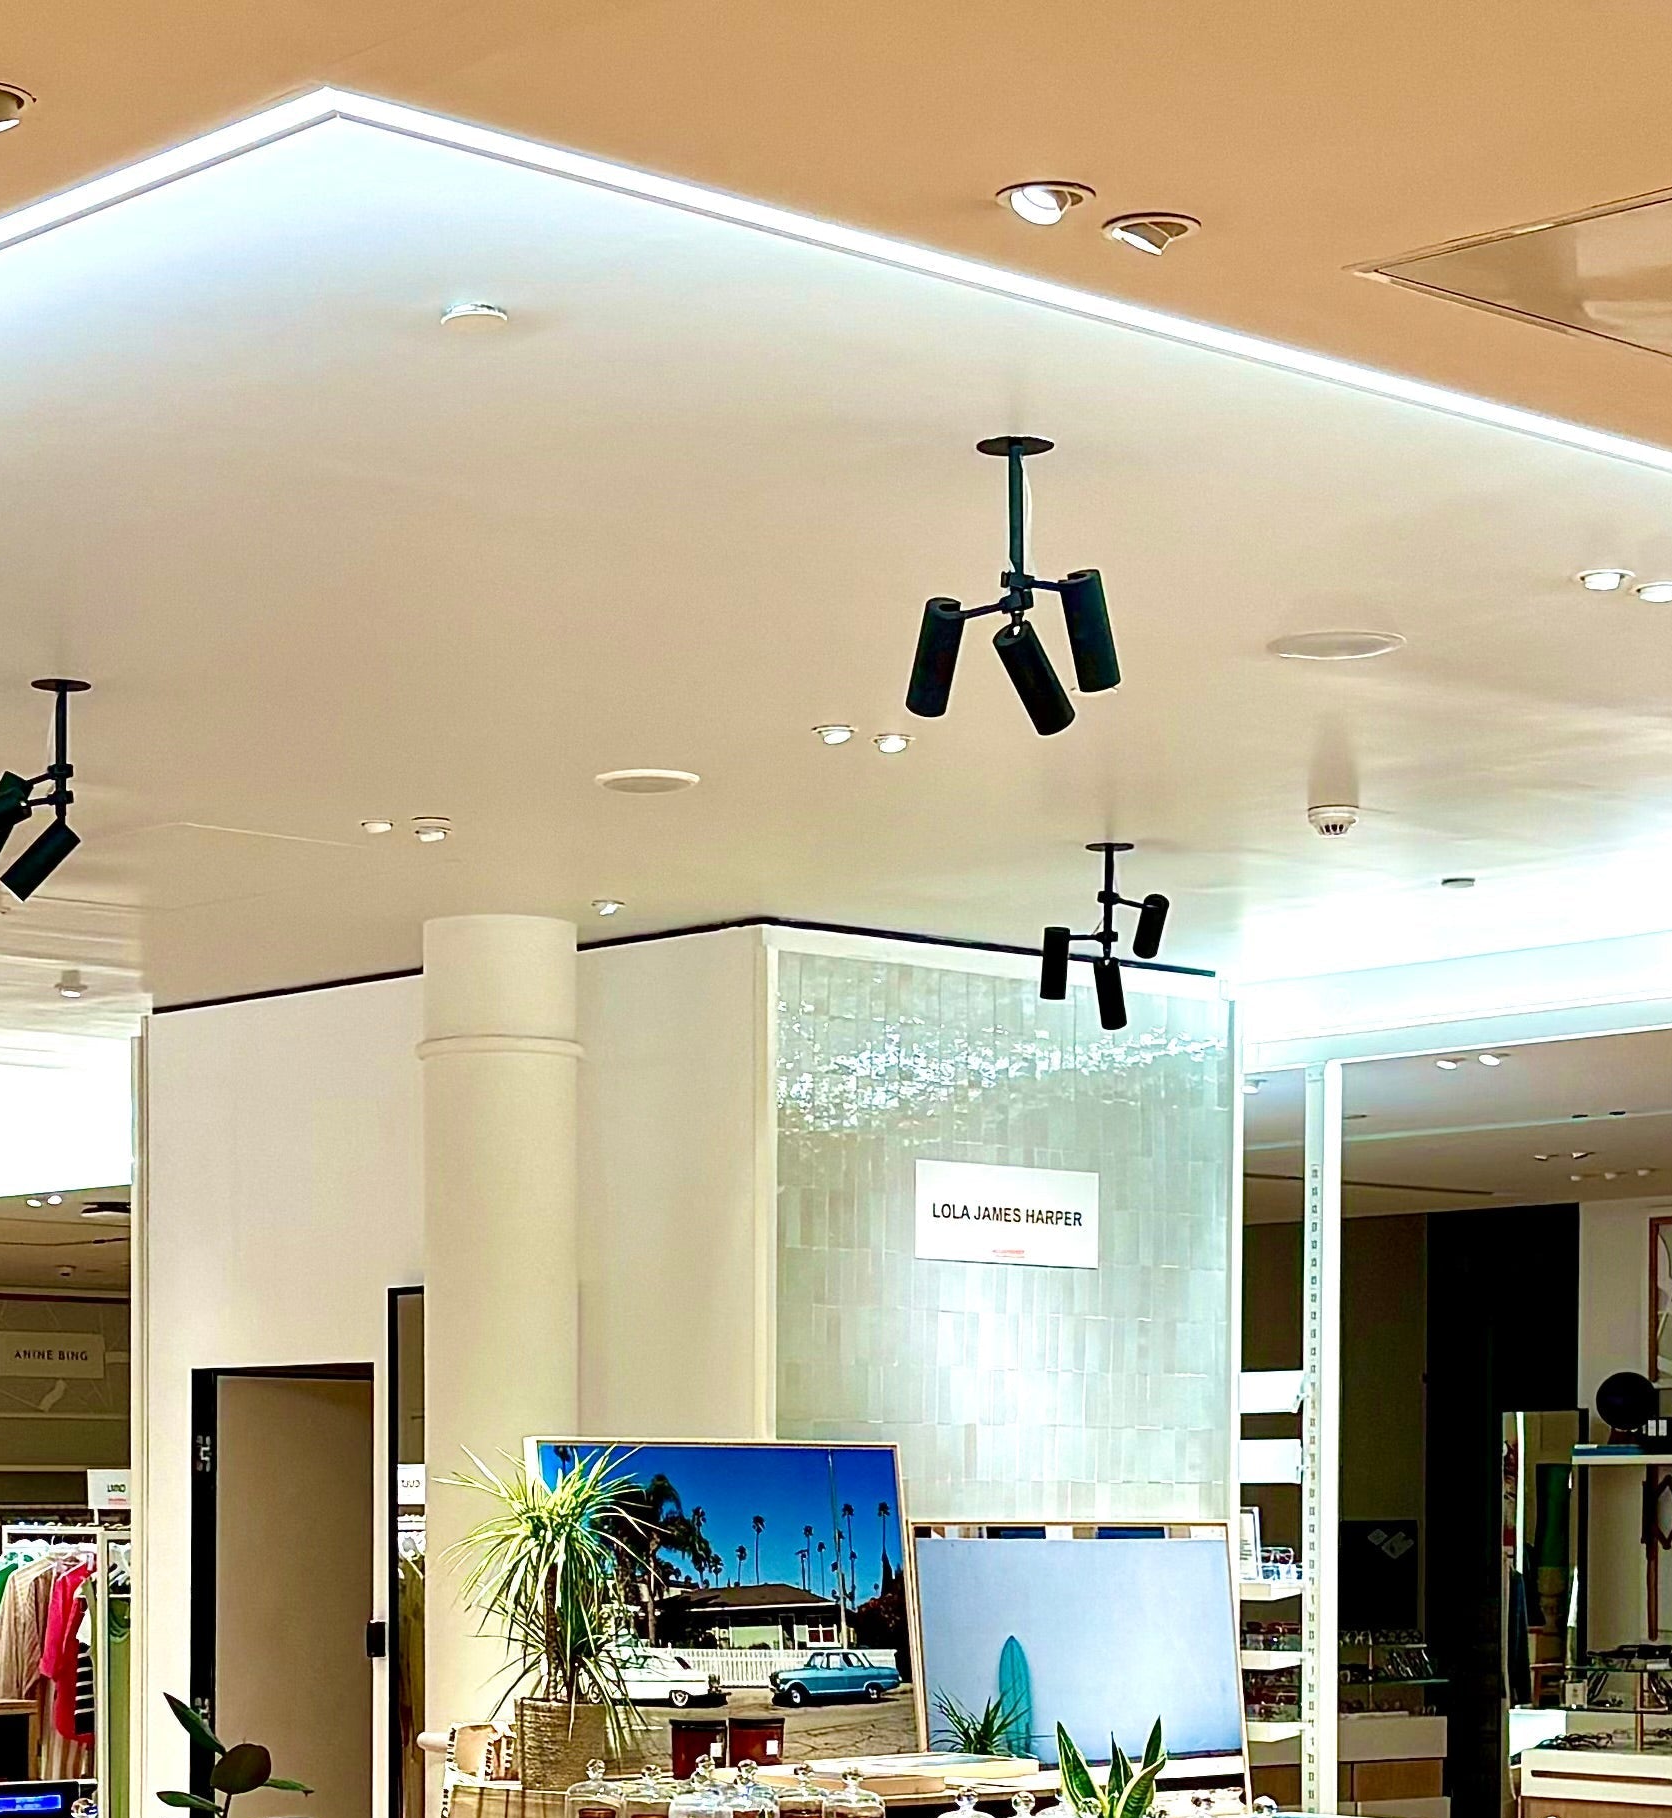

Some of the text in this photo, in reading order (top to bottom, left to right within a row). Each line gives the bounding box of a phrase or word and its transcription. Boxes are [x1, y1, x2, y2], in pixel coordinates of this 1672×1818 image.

[932, 1202, 1083, 1227] LOLA JAMES HARPER
[14, 1349, 88, 1361] ANINE BING
